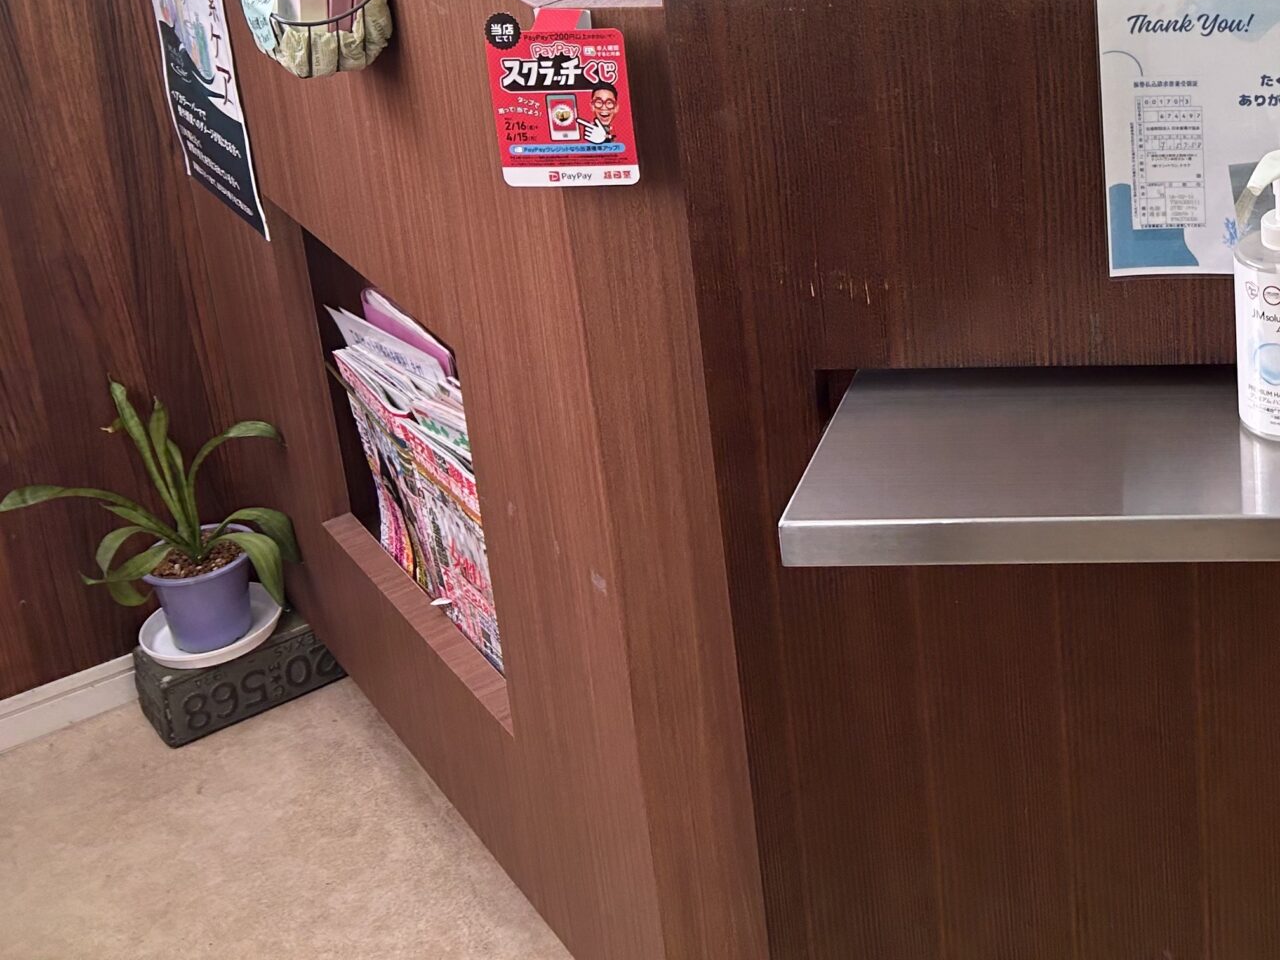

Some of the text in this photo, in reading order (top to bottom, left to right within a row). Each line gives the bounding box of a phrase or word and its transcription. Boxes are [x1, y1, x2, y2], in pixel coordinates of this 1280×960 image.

[490, 23, 515, 36] 当店
[1127, 12, 1256, 38] Thank You!
[533, 42, 580, 59] PayPay
[502, 58, 618, 87] スクラッチくじ
[561, 172, 593, 181] PayPay
